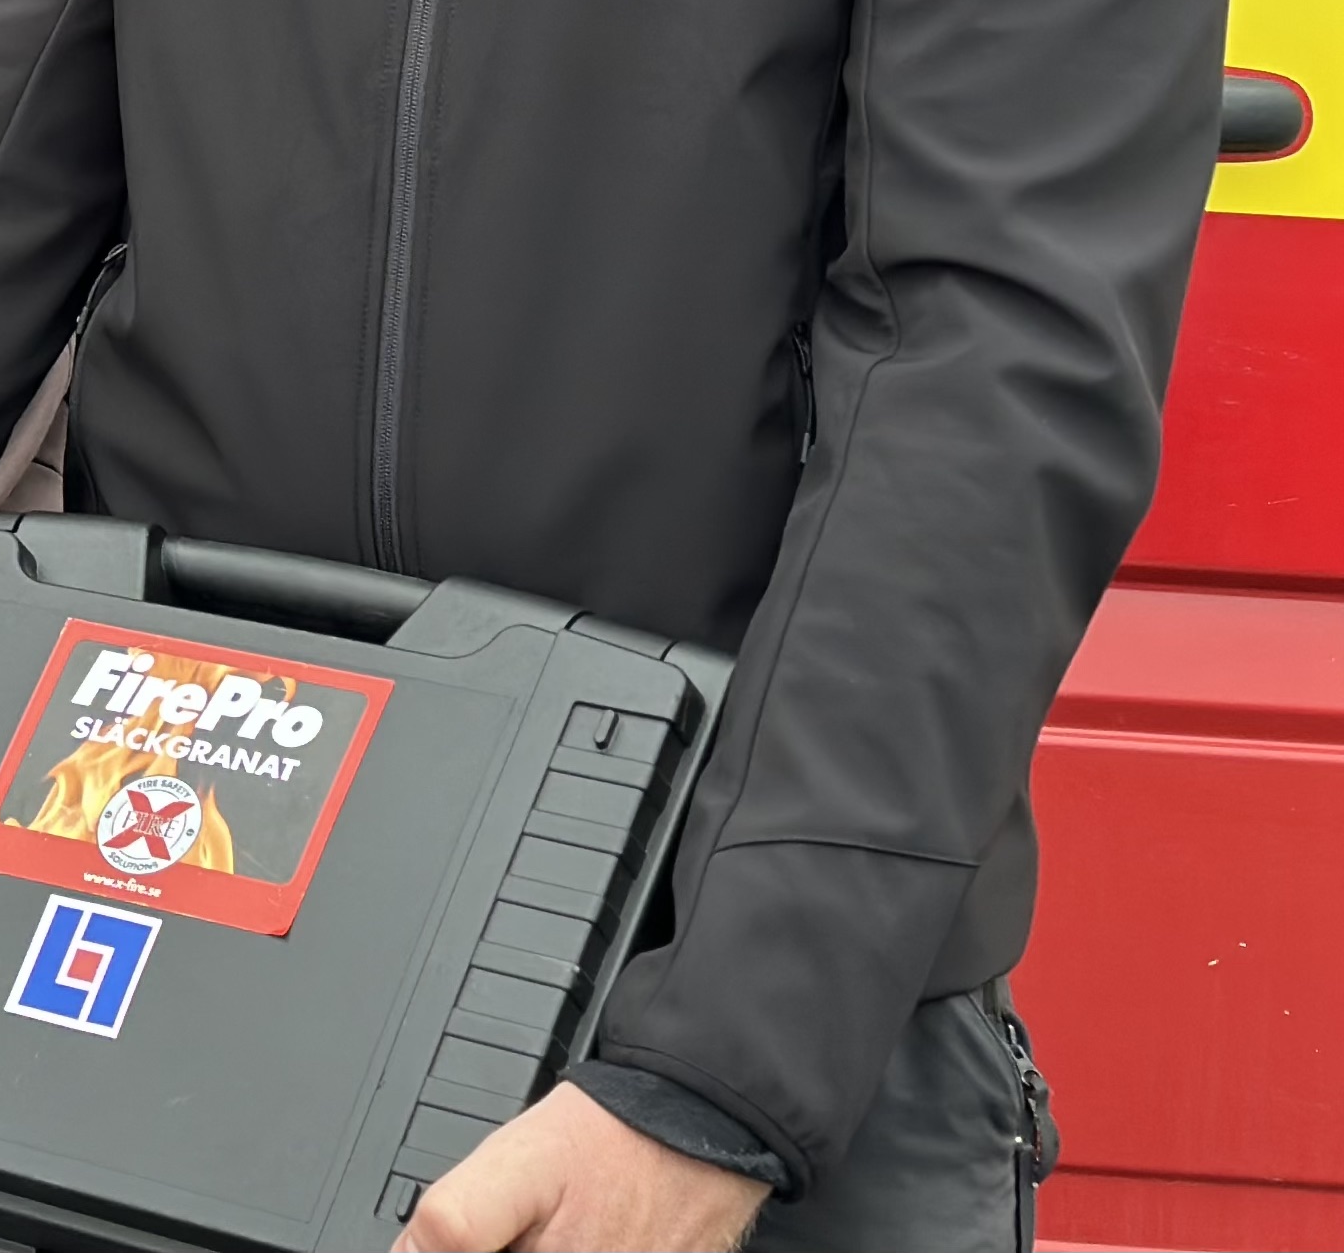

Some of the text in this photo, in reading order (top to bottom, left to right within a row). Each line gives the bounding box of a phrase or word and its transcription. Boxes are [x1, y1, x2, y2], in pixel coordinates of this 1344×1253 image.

[71, 649, 324, 748] FirePro
[70, 715, 301, 782] SLÄCKGRANAT
[137, 779, 192, 798] FIRE SAFETY
[121, 810, 180, 839] FIRE
[107, 851, 159, 871] SOLUTIONS
[83, 872, 162, 898] www.x-fire.se
